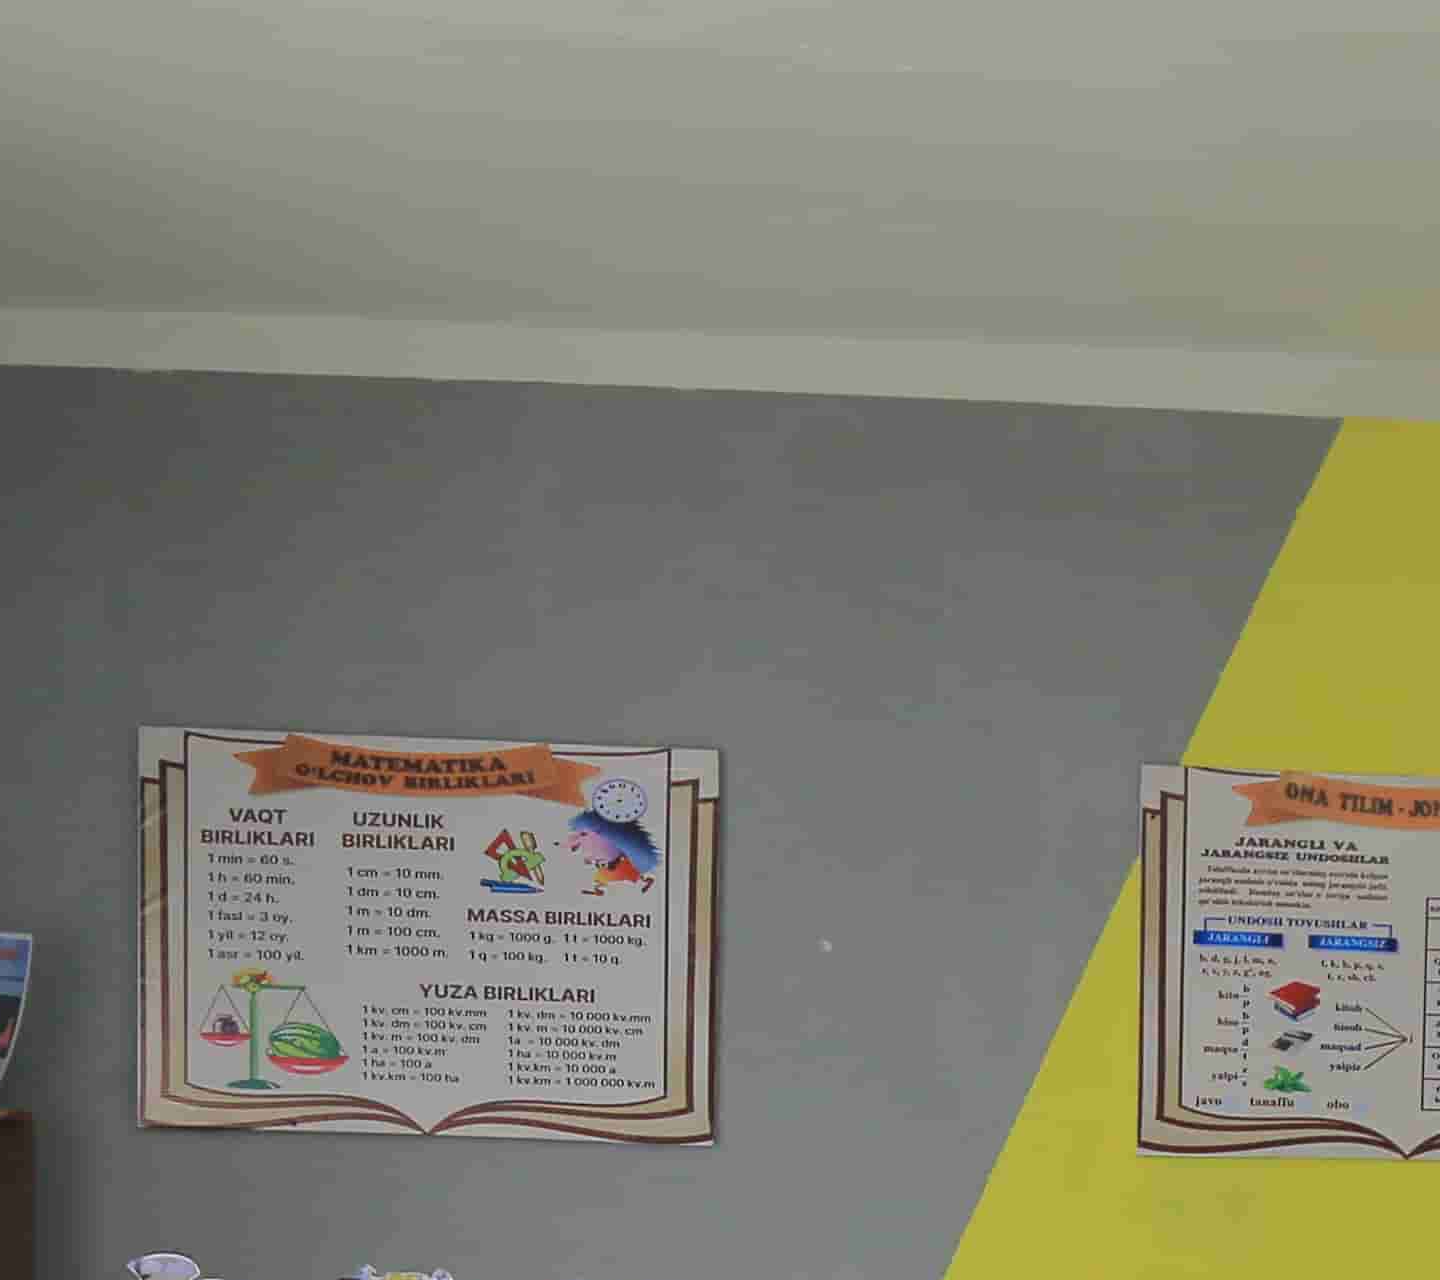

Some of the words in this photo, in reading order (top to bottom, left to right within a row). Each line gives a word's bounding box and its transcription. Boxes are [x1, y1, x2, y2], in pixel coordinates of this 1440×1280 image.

[330, 750, 507, 774] MATEMATIKA
[403, 770, 536, 790] BIRLIKLARI
[1286, 782, 1329, 807] ONA
[1340, 792, 1393, 815] TILIM
[229, 808, 287, 824] VAQT
[353, 811, 444, 829] UZUNLIK
[200, 830, 315, 847] BIRLIKLARI
[342, 834, 455, 851] BIRLIKLARI
[1333, 840, 1358, 851] VA
[218, 853, 243, 865] min
[260, 855, 278, 865] 60
[244, 873, 262, 884] 60
[266, 874, 295, 885] min.
[357, 869, 378, 879] cm
[396, 868, 411, 879] 10
[415, 870, 444, 880] mm.
[244, 893, 262, 903] 24
[266, 893, 280, 904] h.
[357, 886, 378, 897] dm
[395, 887, 411, 898] 10
[415, 890, 440, 900] cm.
[273, 914, 293, 924] oy.
[357, 907, 370, 917] m
[387, 906, 402, 918] 10
[406, 907, 432, 919] dm.
[467, 908, 539, 923] MASSA
[545, 911, 651, 928] BIRLIKLARI
[218, 930, 233, 942] yil
[250, 931, 265, 941] 12
[270, 933, 288, 944] oy.
[357, 928, 370, 936] m
[388, 927, 412, 937] 100
[415, 929, 440, 938] cm.
[479, 932, 494, 943] kg
[510, 933, 540, 943] 1000
[594, 934, 624, 945] 1000
[218, 951, 238, 960] asr
[257, 950, 281, 961] 100
[286, 950, 304, 962] yil.
[357, 945, 377, 956] km
[394, 946, 429, 957] 1000
[433, 948, 449, 958] m.
[504, 951, 525, 961] 100
[593, 953, 607, 964] 10
[420, 984, 478, 999] YUZA
[484, 985, 595, 1004] BIRLIKLARI
